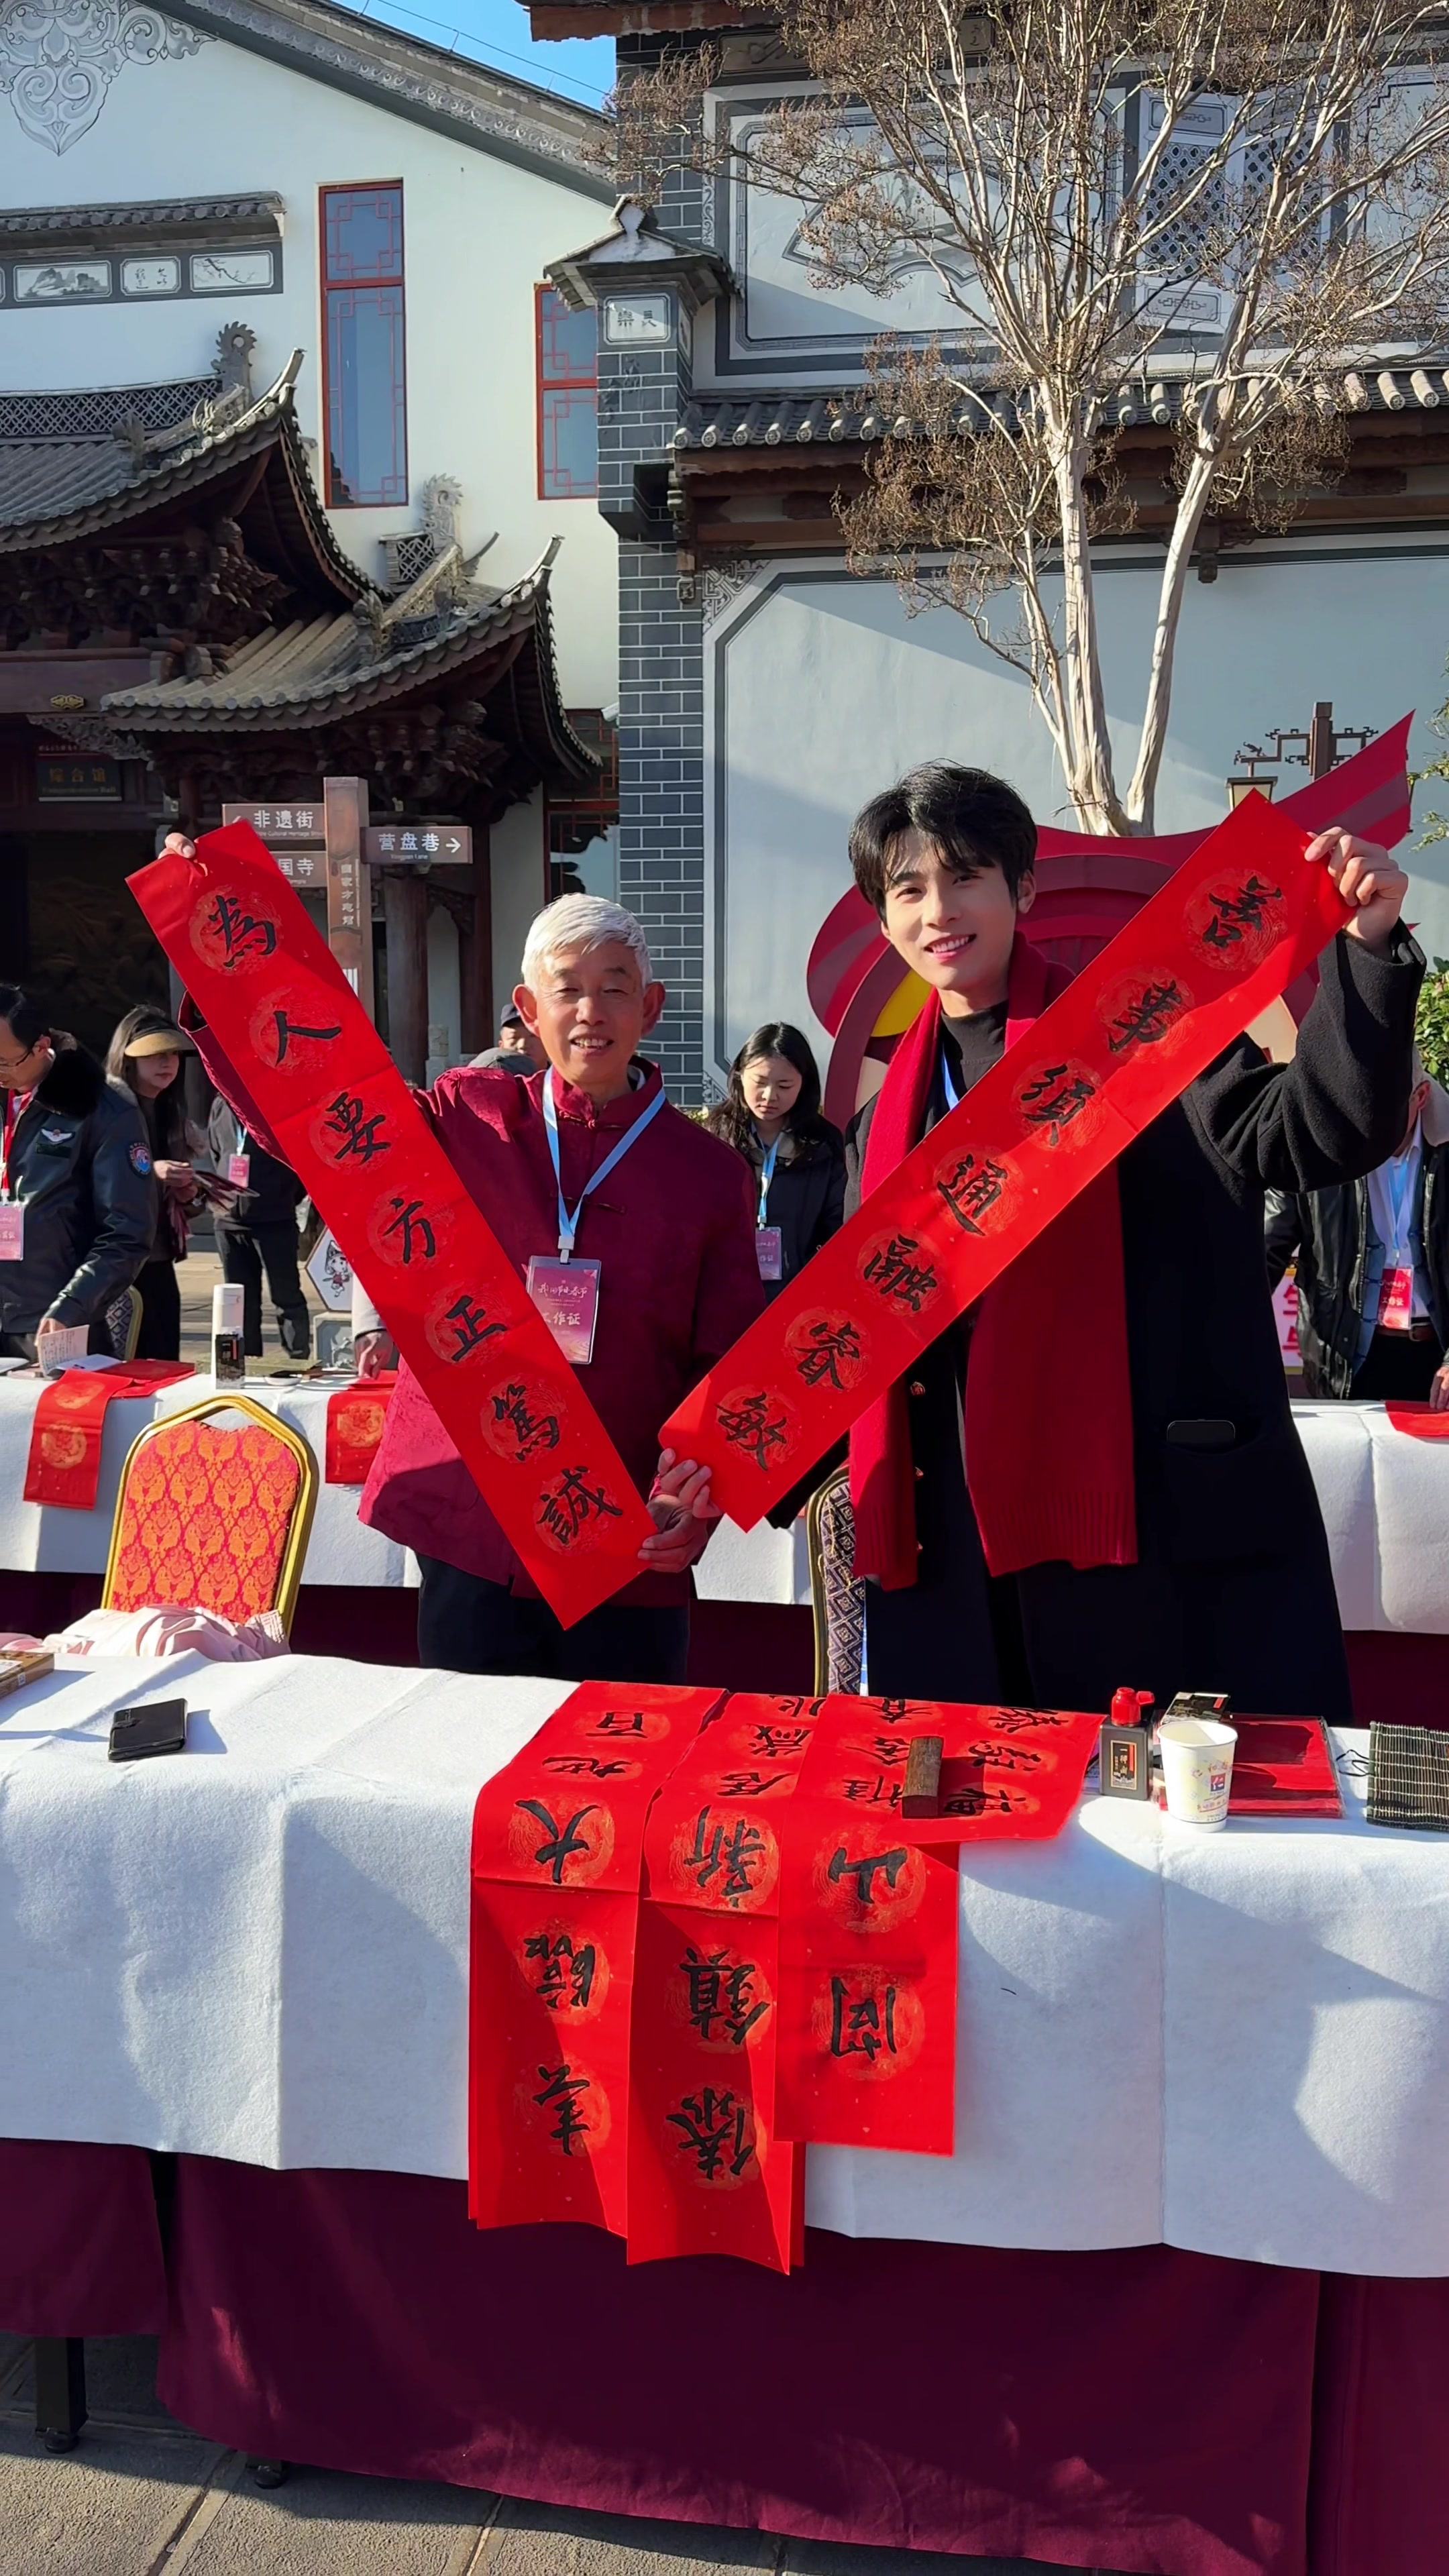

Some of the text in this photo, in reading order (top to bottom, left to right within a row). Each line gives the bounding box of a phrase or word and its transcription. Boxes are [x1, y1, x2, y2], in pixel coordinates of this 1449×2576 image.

[254, 810, 313, 828] 非遗街
[378, 832, 439, 851] 营盘巷
[278, 859, 314, 875] 国寺
